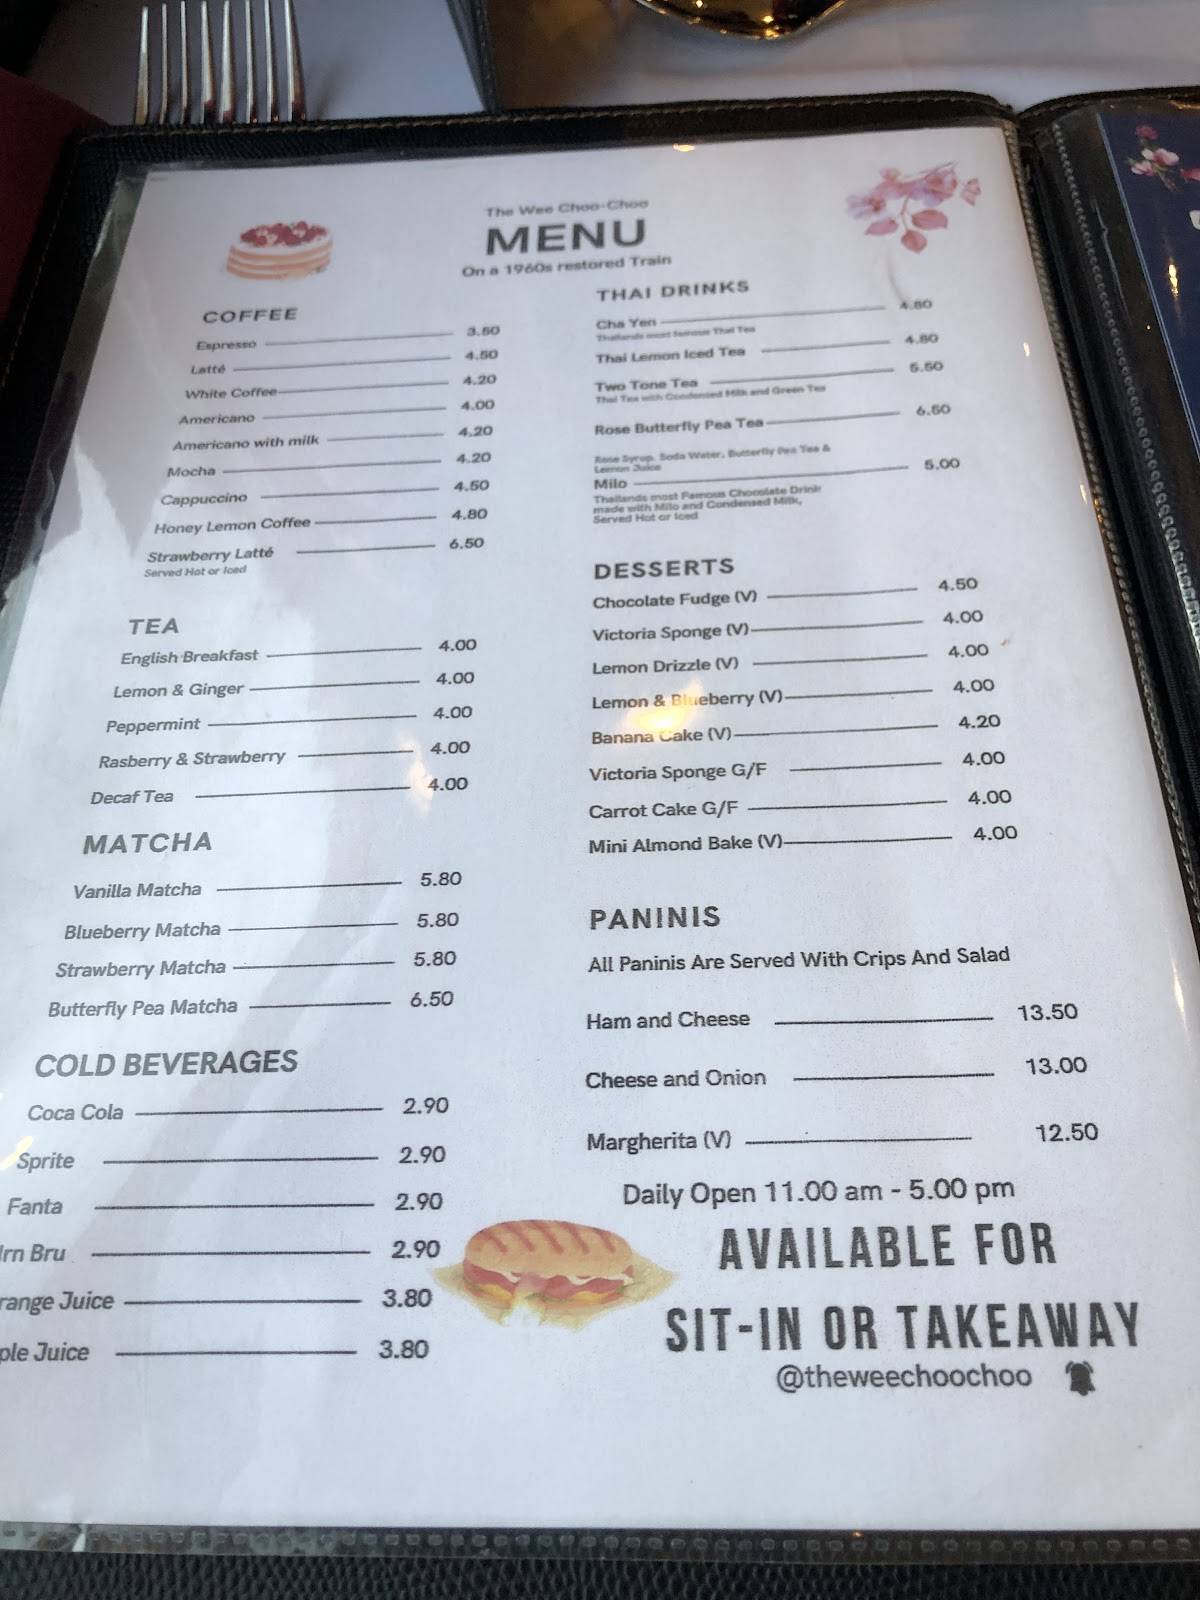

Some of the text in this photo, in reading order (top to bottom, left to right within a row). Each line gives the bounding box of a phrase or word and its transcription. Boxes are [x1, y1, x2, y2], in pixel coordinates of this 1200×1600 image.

[487, 200, 648, 217] The Wee Choo-Choo
[486, 218, 646, 256] MENU
[462, 255, 672, 277] On a 1960s restored Train
[596, 280, 749, 302] THAI DRINKS
[203, 307, 298, 323] COFFEE
[191, 349, 498, 375] Latté 4.50
[596, 333, 939, 364] Thai Lemon Iced Tea 4.80
[185, 374, 497, 399] White Coffee 4.20
[179, 399, 495, 424] Americano 4.00
[594, 404, 951, 435] Rose Butterfly Pea Tea 6.50
[173, 425, 493, 451] Americano with milk 4.20
[167, 451, 492, 477] Mocha 4.20
[594, 457, 960, 489] Milo 5.00
[161, 479, 490, 508] Cappuccino 4.50
[154, 508, 488, 536] Honey Lemon Coffee 4.80
[147, 537, 485, 563] Strawberry Latté 6.50
[144, 568, 183, 577] Served
[184, 567, 206, 576] Hot
[223, 565, 247, 575] Iced
[594, 558, 735, 580] DESSERTS
[592, 576, 978, 609] Chocolate Fudge (V) 4.50
[129, 617, 179, 635] TEA
[592, 610, 984, 642] Victoria Sponge (V) 4.00
[121, 638, 477, 667] English Breakfast 4.00
[592, 643, 989, 675] Lemon Drizzle (V) 4.00
[113, 672, 475, 698] Lemon & Ginger 4.00
[106, 706, 473, 736] Peppermint 4.00
[99, 741, 471, 770] Rasberry & Strawberry 4.00
[588, 751, 1005, 782] Victoria Sponge G/F 4.00
[90, 777, 469, 805] Decaf Tea 4.00
[589, 789, 1012, 819] Carrot Cake G/F 4.00
[83, 832, 212, 857] MATCHA
[588, 825, 1018, 854] Mini Almond Bake (V) 4.00
[74, 871, 462, 899] Vanilla Matcha 5.80
[64, 912, 459, 942] Blueberry Matcha 5.80
[589, 905, 721, 931] PANINIS
[55, 950, 457, 980] Strawberry Matcha 5.80
[587, 946, 1011, 973] All Paninis Are Served With Crips And Salad
[48, 990, 454, 1020] Butterfly Pea Matcha 6.50
[586, 1003, 1078, 1030] Ham and Cheese 13.50
[35, 1049, 298, 1078] COLD BEVERAGES
[585, 1056, 1088, 1090] Cheese and Onion 13.00
[28, 1097, 449, 1121] Coca Cola 2.90
[586, 1122, 1099, 1157] Margherita (V) 12.50
[16, 1145, 446, 1174] Sprite 2.90
[7, 1192, 443, 1216] Fanta 2.90
[623, 1182, 685, 1210] Daily
[689, 1182, 756, 1210] Open
[764, 1180, 839, 1202] 11.00
[844, 1185, 883, 1201] am
[908, 1177, 968, 1200] 5.00
[974, 1181, 1016, 1204] pm
[717, 1222, 1057, 1271] AVAILABLE FOR
[664, 1301, 1139, 1353] SIT-IN OR TAKEAWAY
[777, 1364, 1032, 1392] @theweechoochoo
